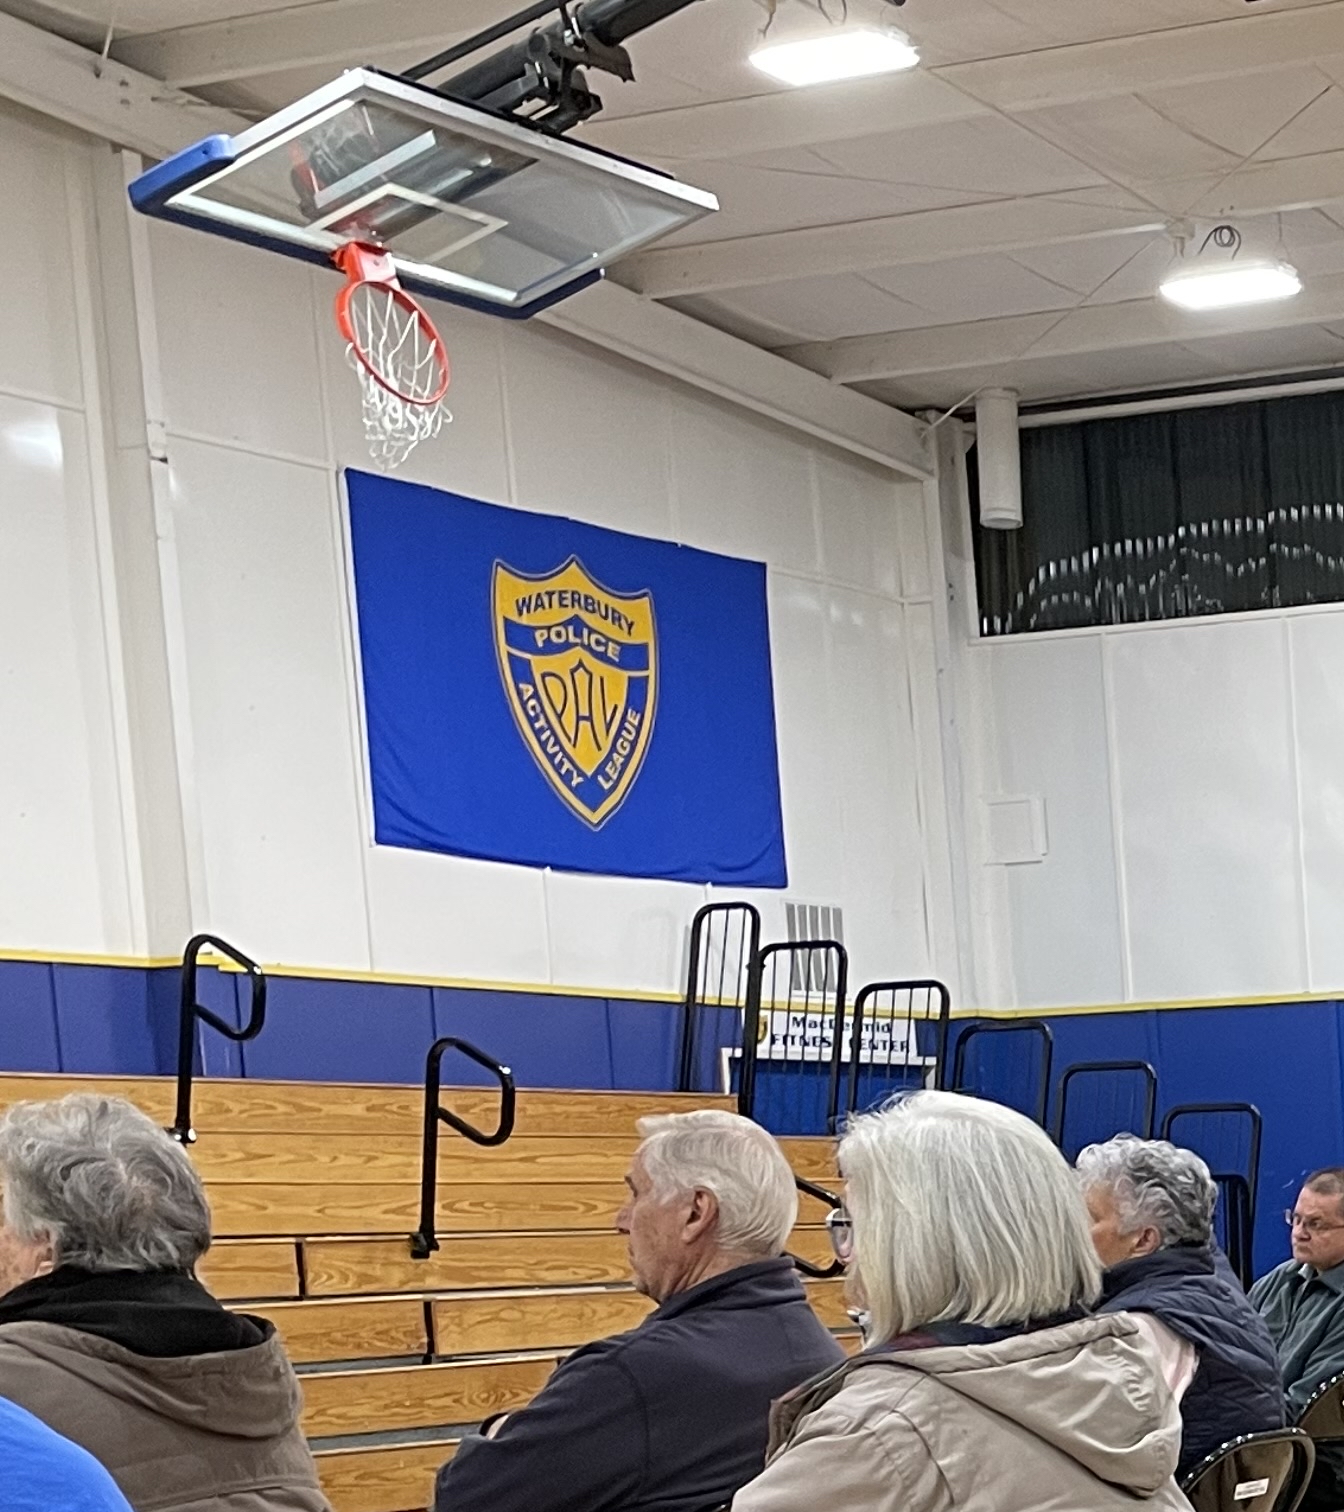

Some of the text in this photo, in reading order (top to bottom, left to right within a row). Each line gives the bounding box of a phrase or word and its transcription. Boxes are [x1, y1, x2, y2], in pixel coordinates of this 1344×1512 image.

[515, 589, 635, 637] WATERBURY
[534, 624, 622, 662] POLICE
[518, 682, 585, 788] ACTIVITY
[597, 708, 641, 790] LEAGUE
[771, 1033, 834, 1048] FITNES
[792, 1015, 891, 1034] MacDemid
